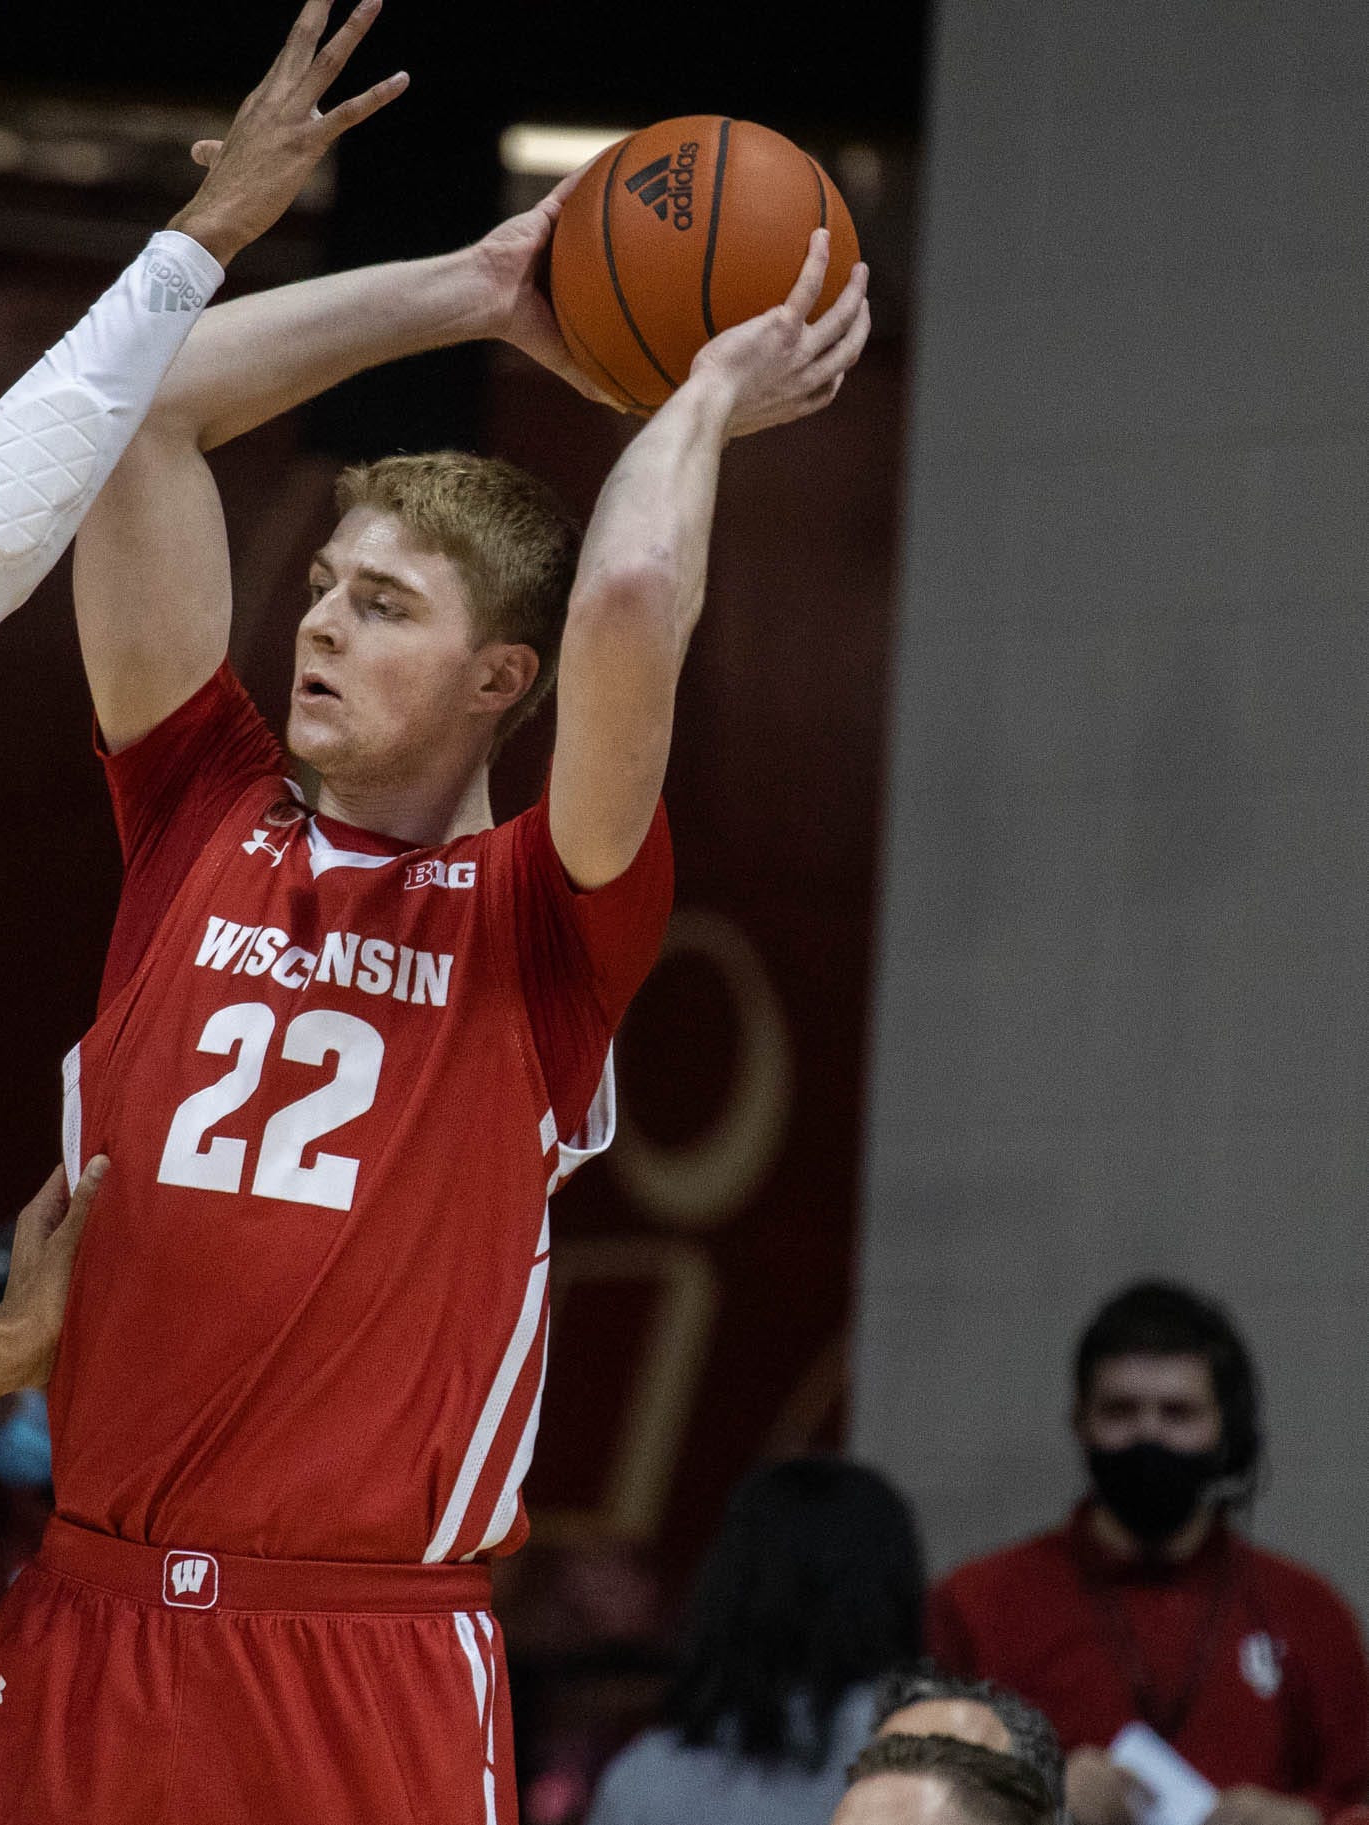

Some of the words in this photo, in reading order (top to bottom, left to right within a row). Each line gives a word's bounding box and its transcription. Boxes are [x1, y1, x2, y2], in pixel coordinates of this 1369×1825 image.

[667, 142, 699, 231] adidas
[148, 262, 203, 308] adidas
[194, 915, 454, 1006] WISCNSIN
[157, 1002, 385, 1211] 22
